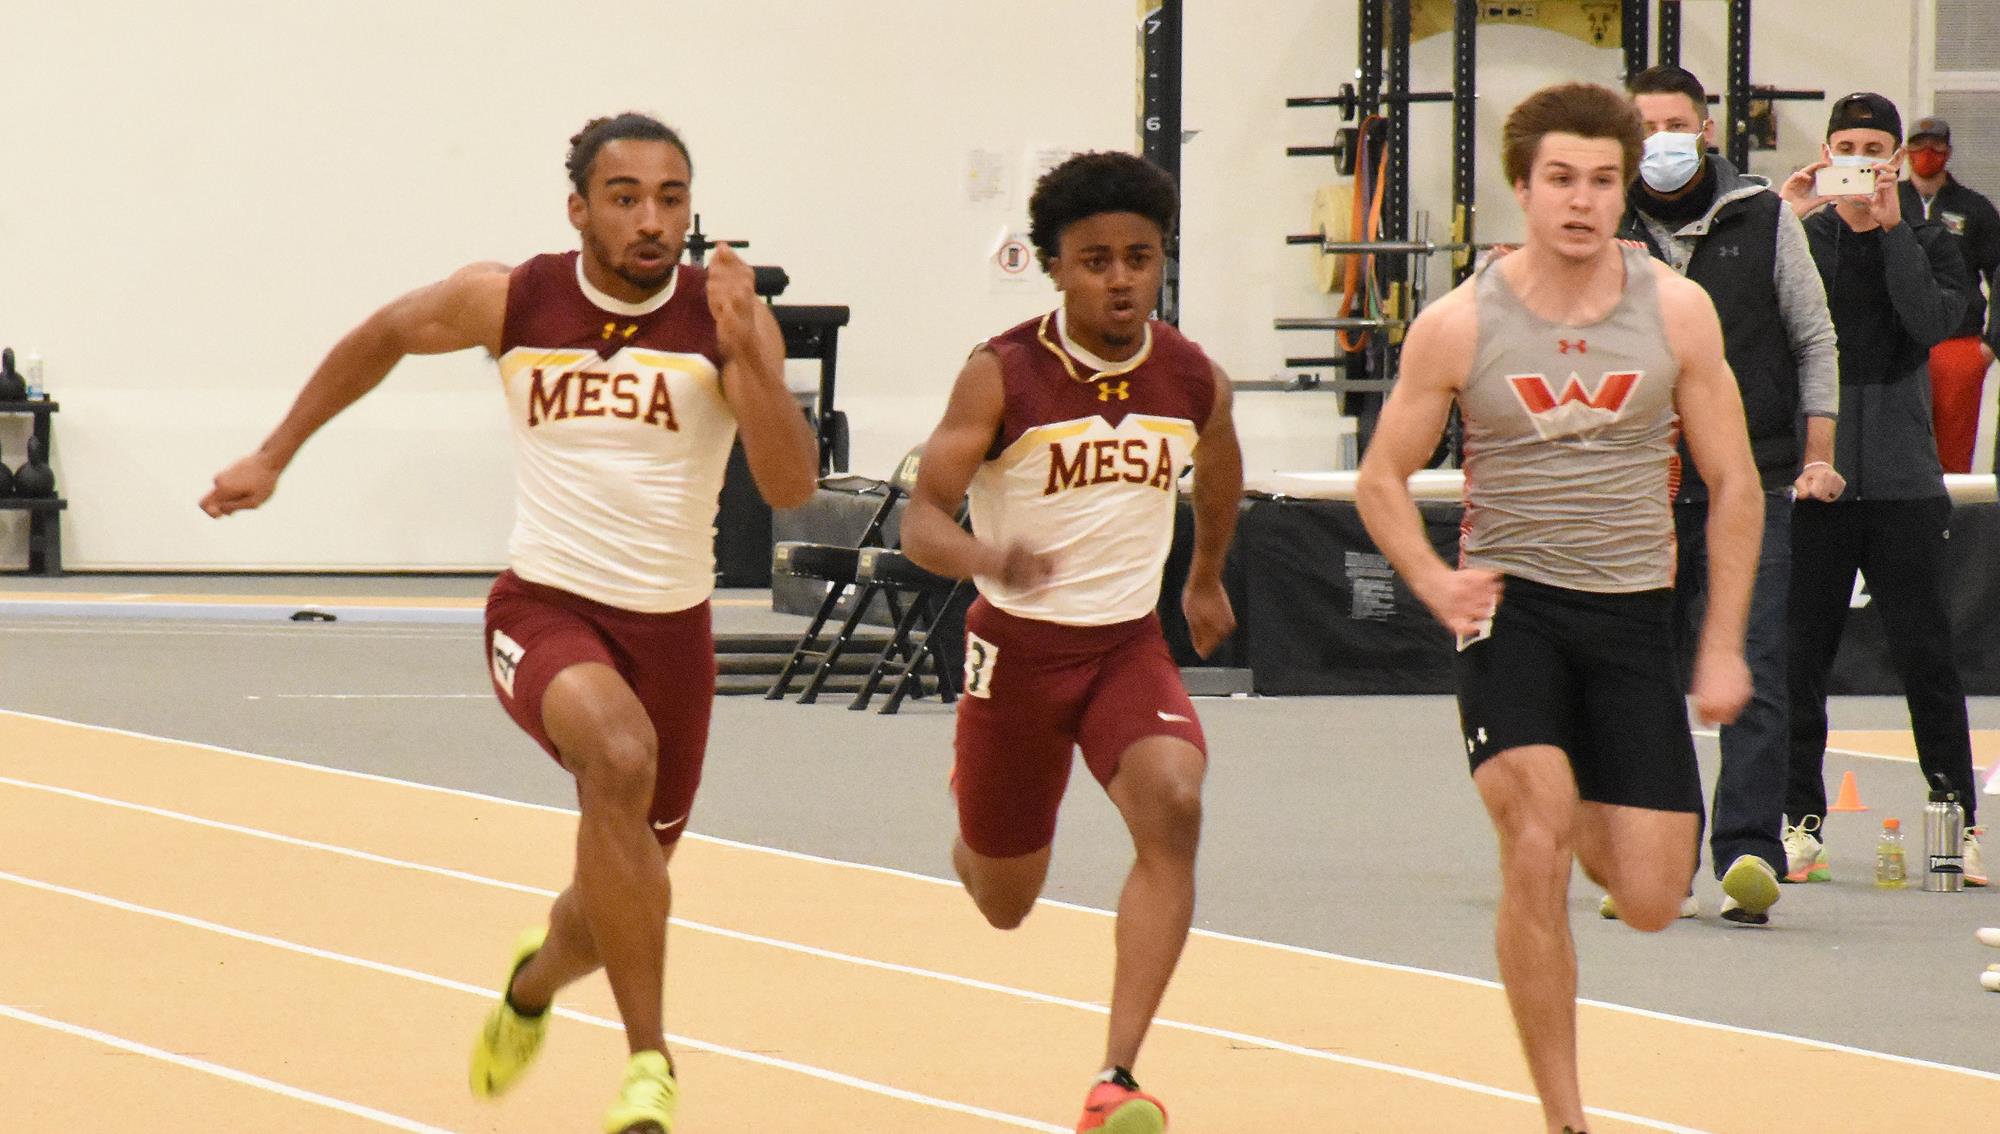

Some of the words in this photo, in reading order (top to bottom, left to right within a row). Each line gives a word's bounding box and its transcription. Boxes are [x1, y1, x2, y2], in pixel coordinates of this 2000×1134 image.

[1146, 20, 1161, 34] 7
[1146, 116, 1161, 131] 6
[528, 368, 680, 433] MESA
[1044, 437, 1172, 496] MESA
